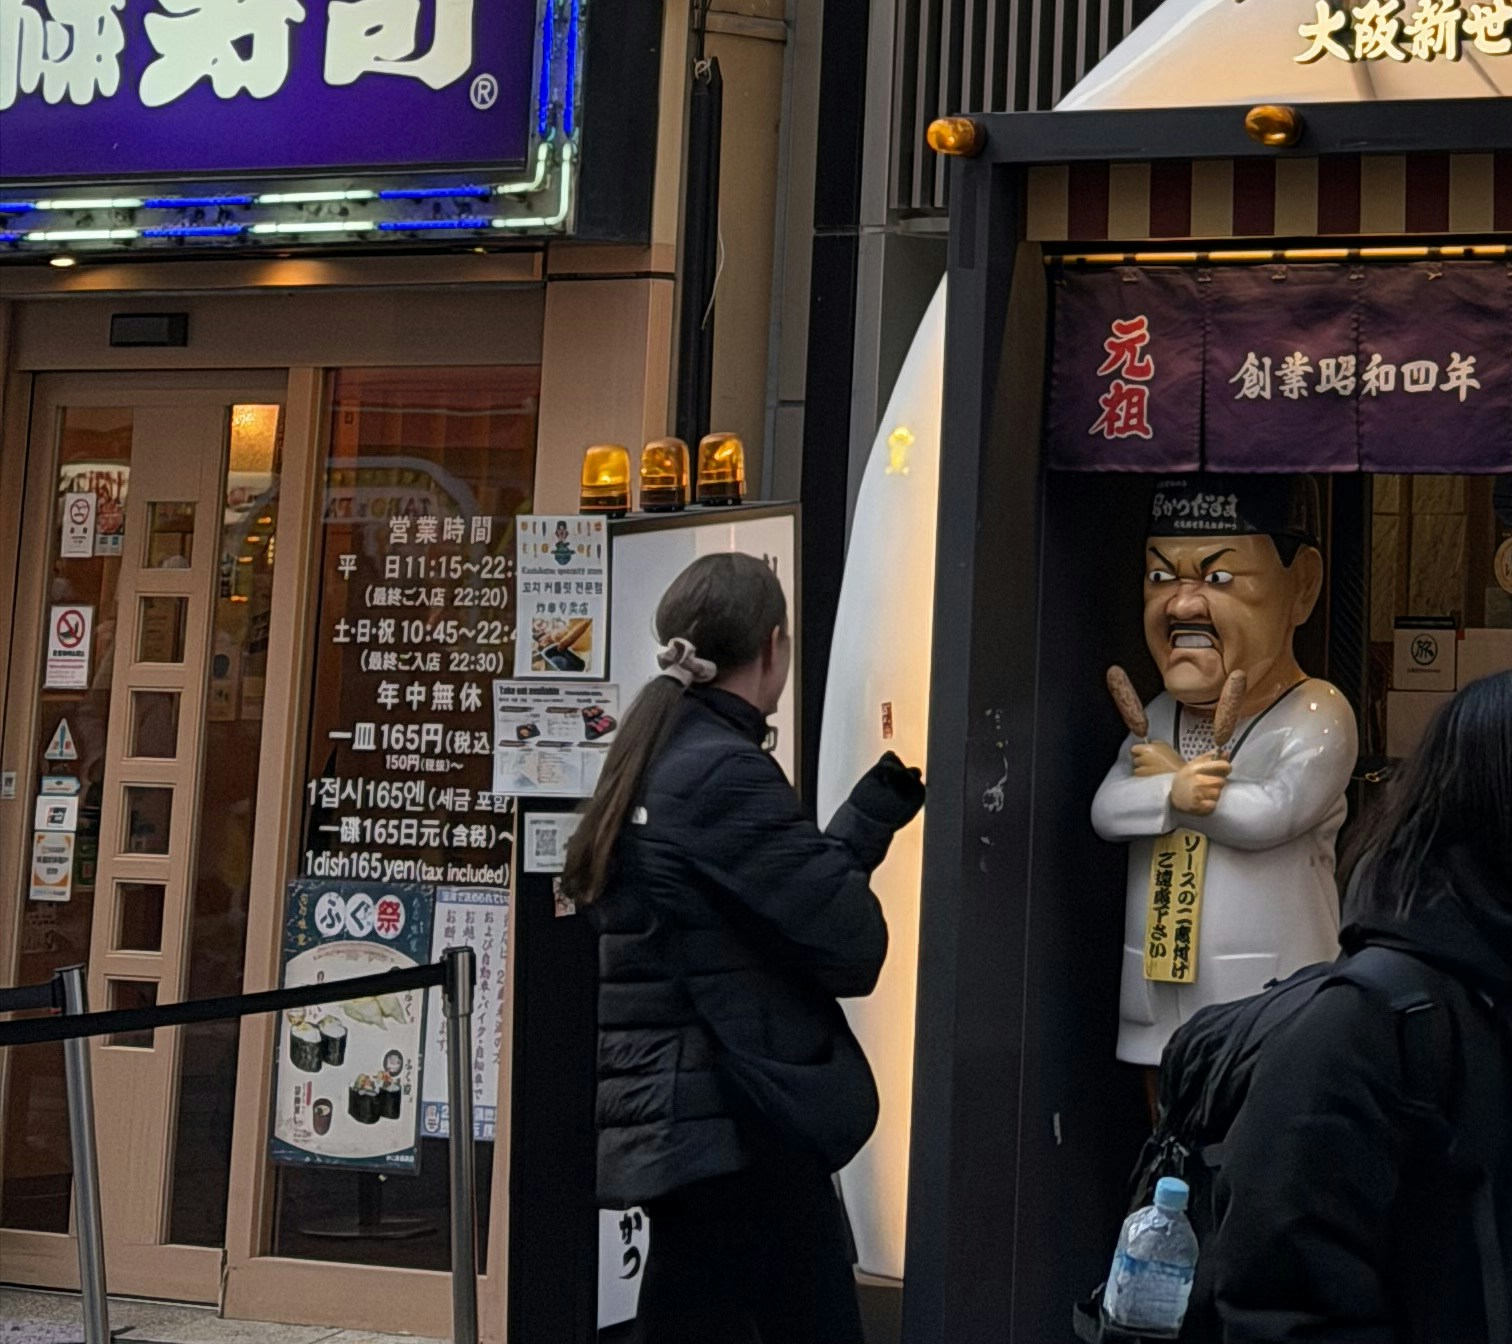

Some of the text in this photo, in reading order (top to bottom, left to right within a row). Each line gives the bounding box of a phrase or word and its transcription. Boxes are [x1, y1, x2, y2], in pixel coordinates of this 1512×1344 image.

[1088, 315, 1155, 440] 元祖
[1230, 350, 1481, 403] 創業昭和四年
[389, 515, 493, 544] 営業時間
[453, 587, 508, 608] 22:20)
[449, 651, 504, 673] 22:30)
[377, 679, 482, 712] 年中無休
[319, 898, 401, 934] ふぐ祭
